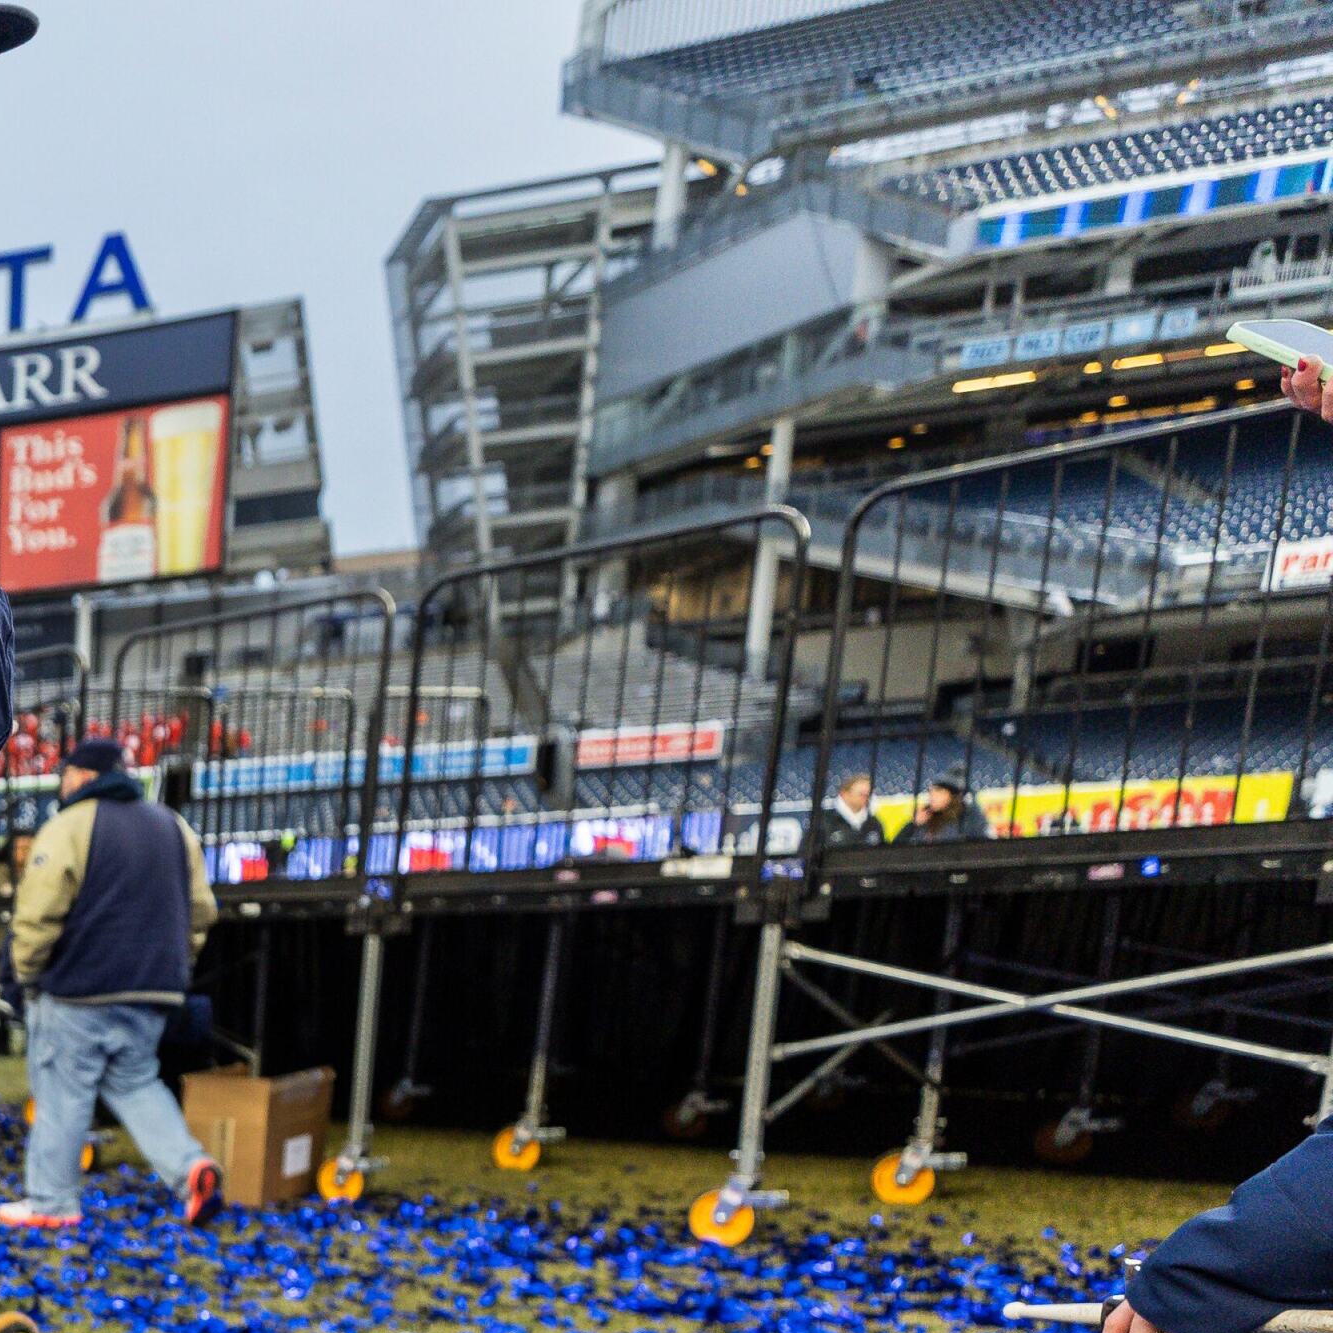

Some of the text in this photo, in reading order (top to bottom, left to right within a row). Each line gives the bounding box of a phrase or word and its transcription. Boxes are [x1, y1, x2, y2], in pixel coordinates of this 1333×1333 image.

[9, 430, 84, 464] This
[10, 458, 97, 497] Bud's
[9, 493, 64, 523] For
[8, 524, 77, 555] You.
